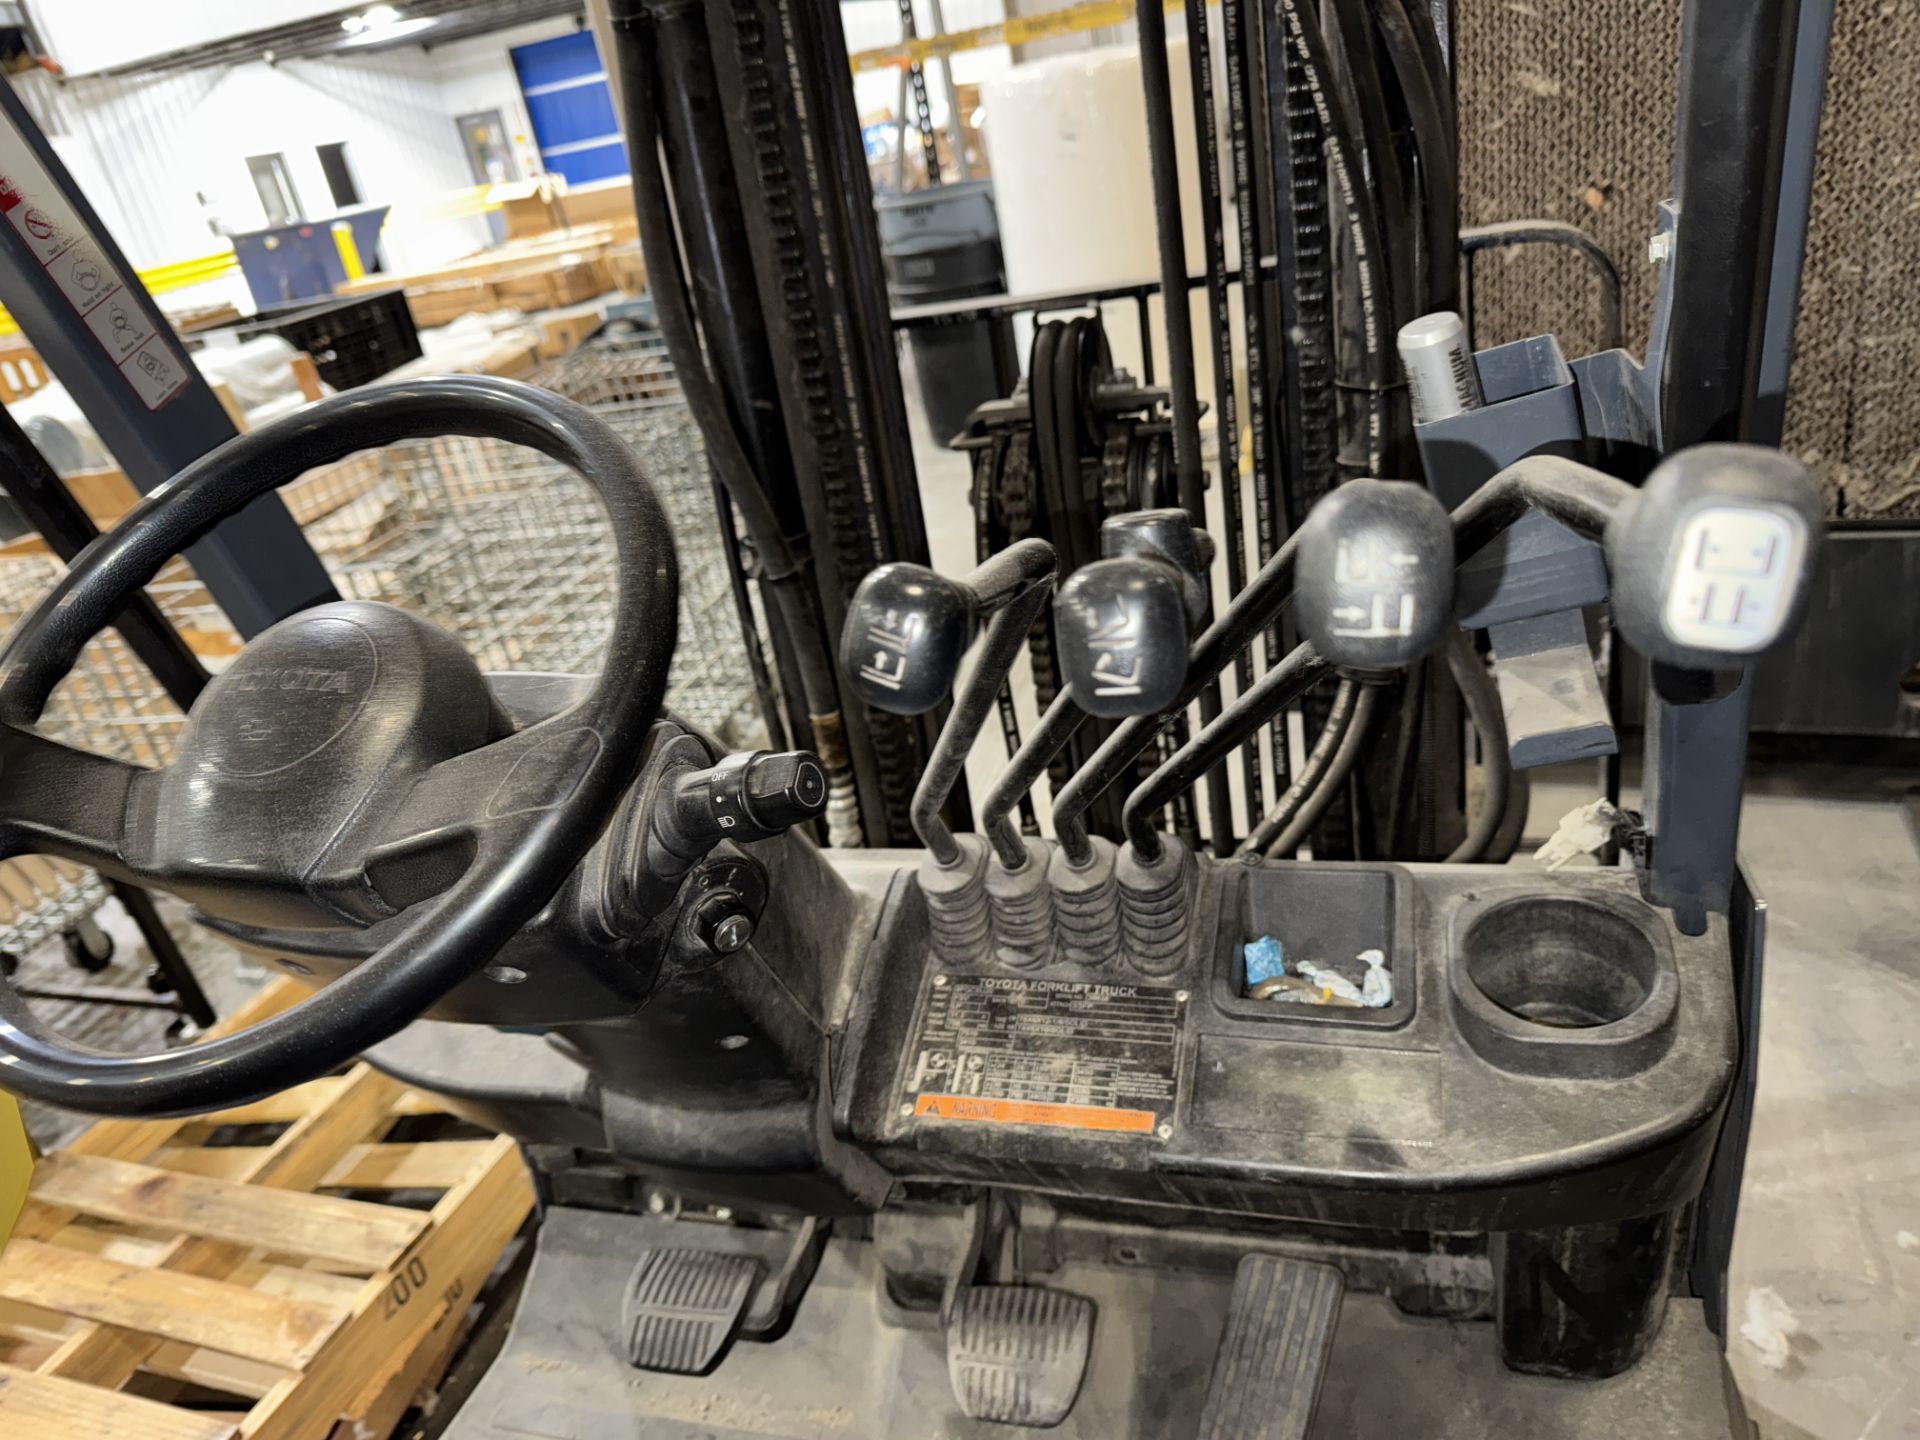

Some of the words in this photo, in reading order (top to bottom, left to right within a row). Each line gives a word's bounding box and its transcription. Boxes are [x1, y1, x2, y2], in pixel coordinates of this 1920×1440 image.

[1288, 12, 1302, 34] PSI
[1296, 36, 1310, 59] WP
[1237, 149, 1250, 185] WIRE
[1351, 222, 1366, 256] WIRE
[1358, 259, 1373, 298] MSHA
[1448, 346, 1476, 411] MAGNUM
[224, 667, 349, 694] TOYOTA
[711, 770, 730, 782] OFF
[979, 977, 1028, 992] TOYOTA
[1029, 981, 1093, 996] FORKLIFT
[1094, 984, 1139, 998] TRUCK
[951, 1100, 998, 1118] WARNING
